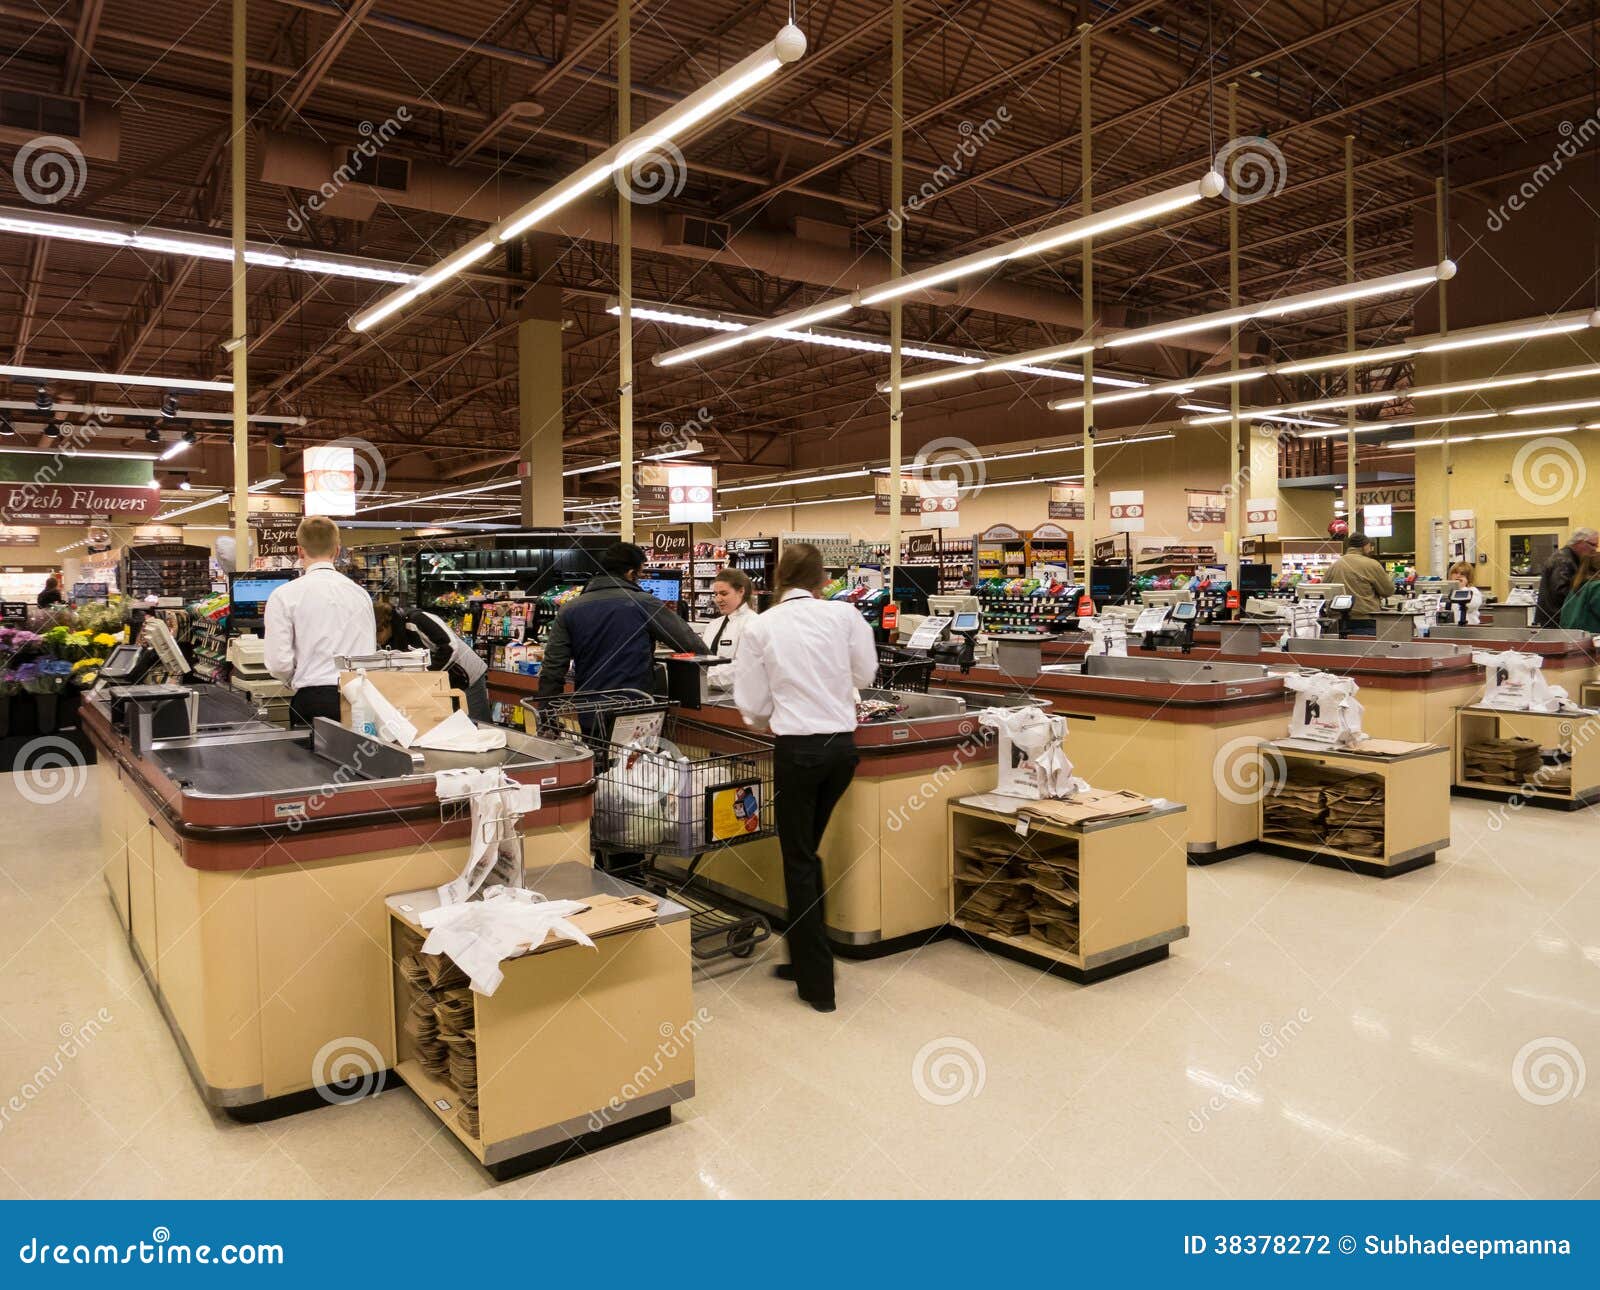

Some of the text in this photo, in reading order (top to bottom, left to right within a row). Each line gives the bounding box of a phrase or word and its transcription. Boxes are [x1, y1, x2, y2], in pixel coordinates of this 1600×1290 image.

[8, 489, 147, 510] Fresh Flowers
[260, 544, 270, 555] 15
[655, 534, 686, 552] Open
[911, 539, 933, 553] Closed
[1097, 544, 1114, 558] Closed
